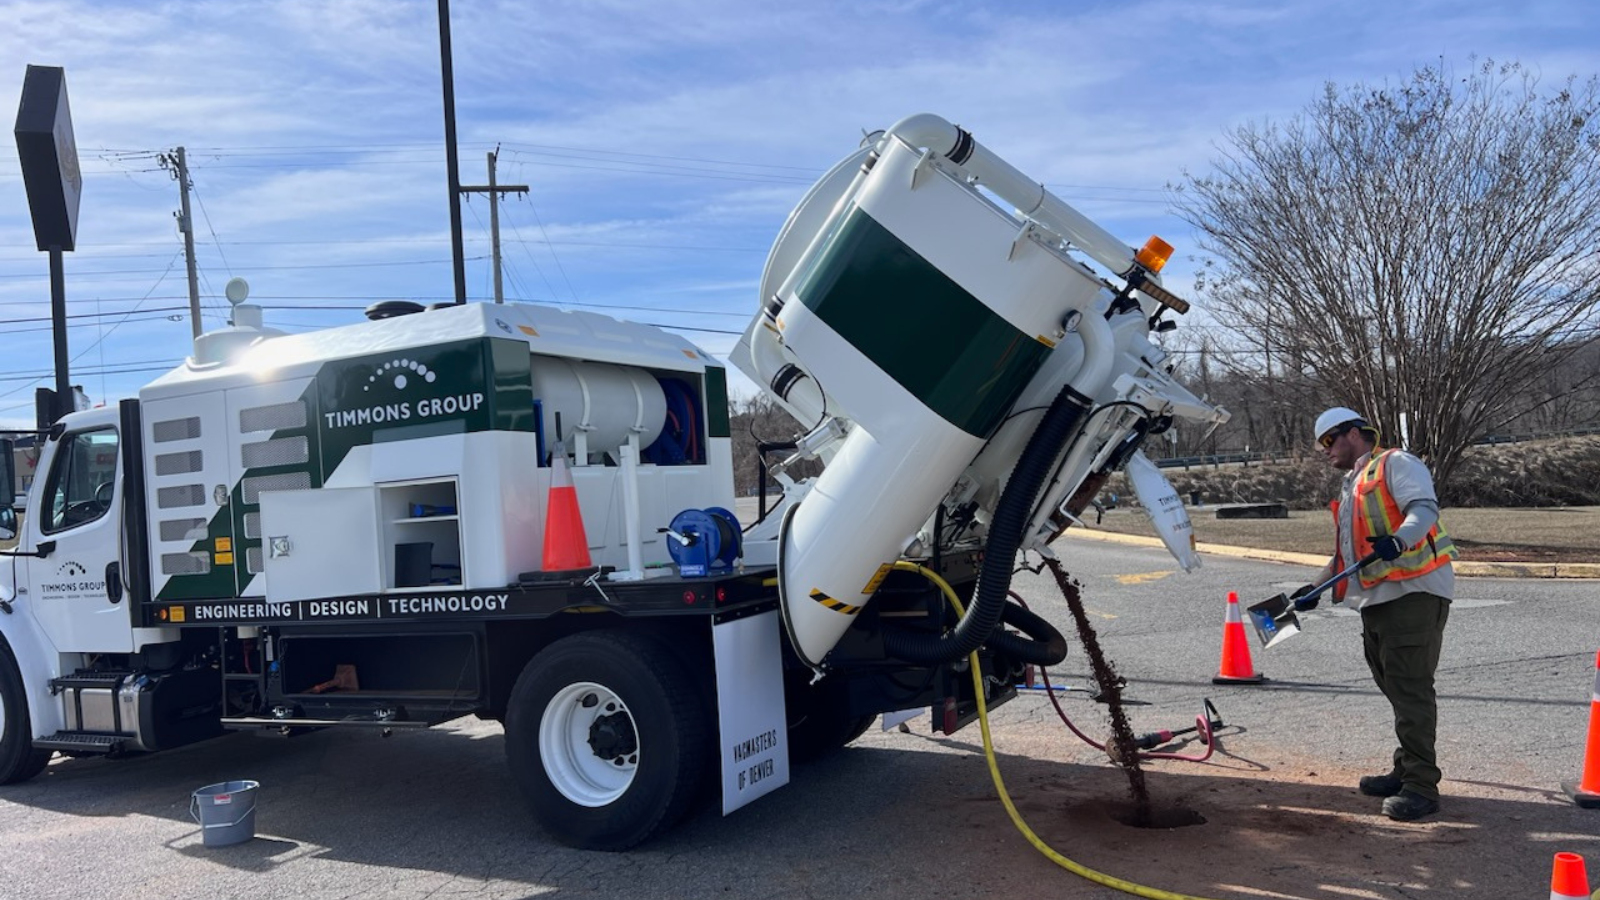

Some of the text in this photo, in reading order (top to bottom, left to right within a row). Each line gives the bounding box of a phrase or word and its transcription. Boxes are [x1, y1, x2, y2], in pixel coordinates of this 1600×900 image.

[325, 392, 484, 429] TIMMONS GROUP
[41, 582, 105, 593] TIMMONS GROUP
[194, 602, 292, 619] ENGINEERING
[310, 600, 369, 616] DESIGN
[388, 594, 509, 614] TECHNOLOGY
[734, 729, 777, 791] VACMASTERS OF DENVER
